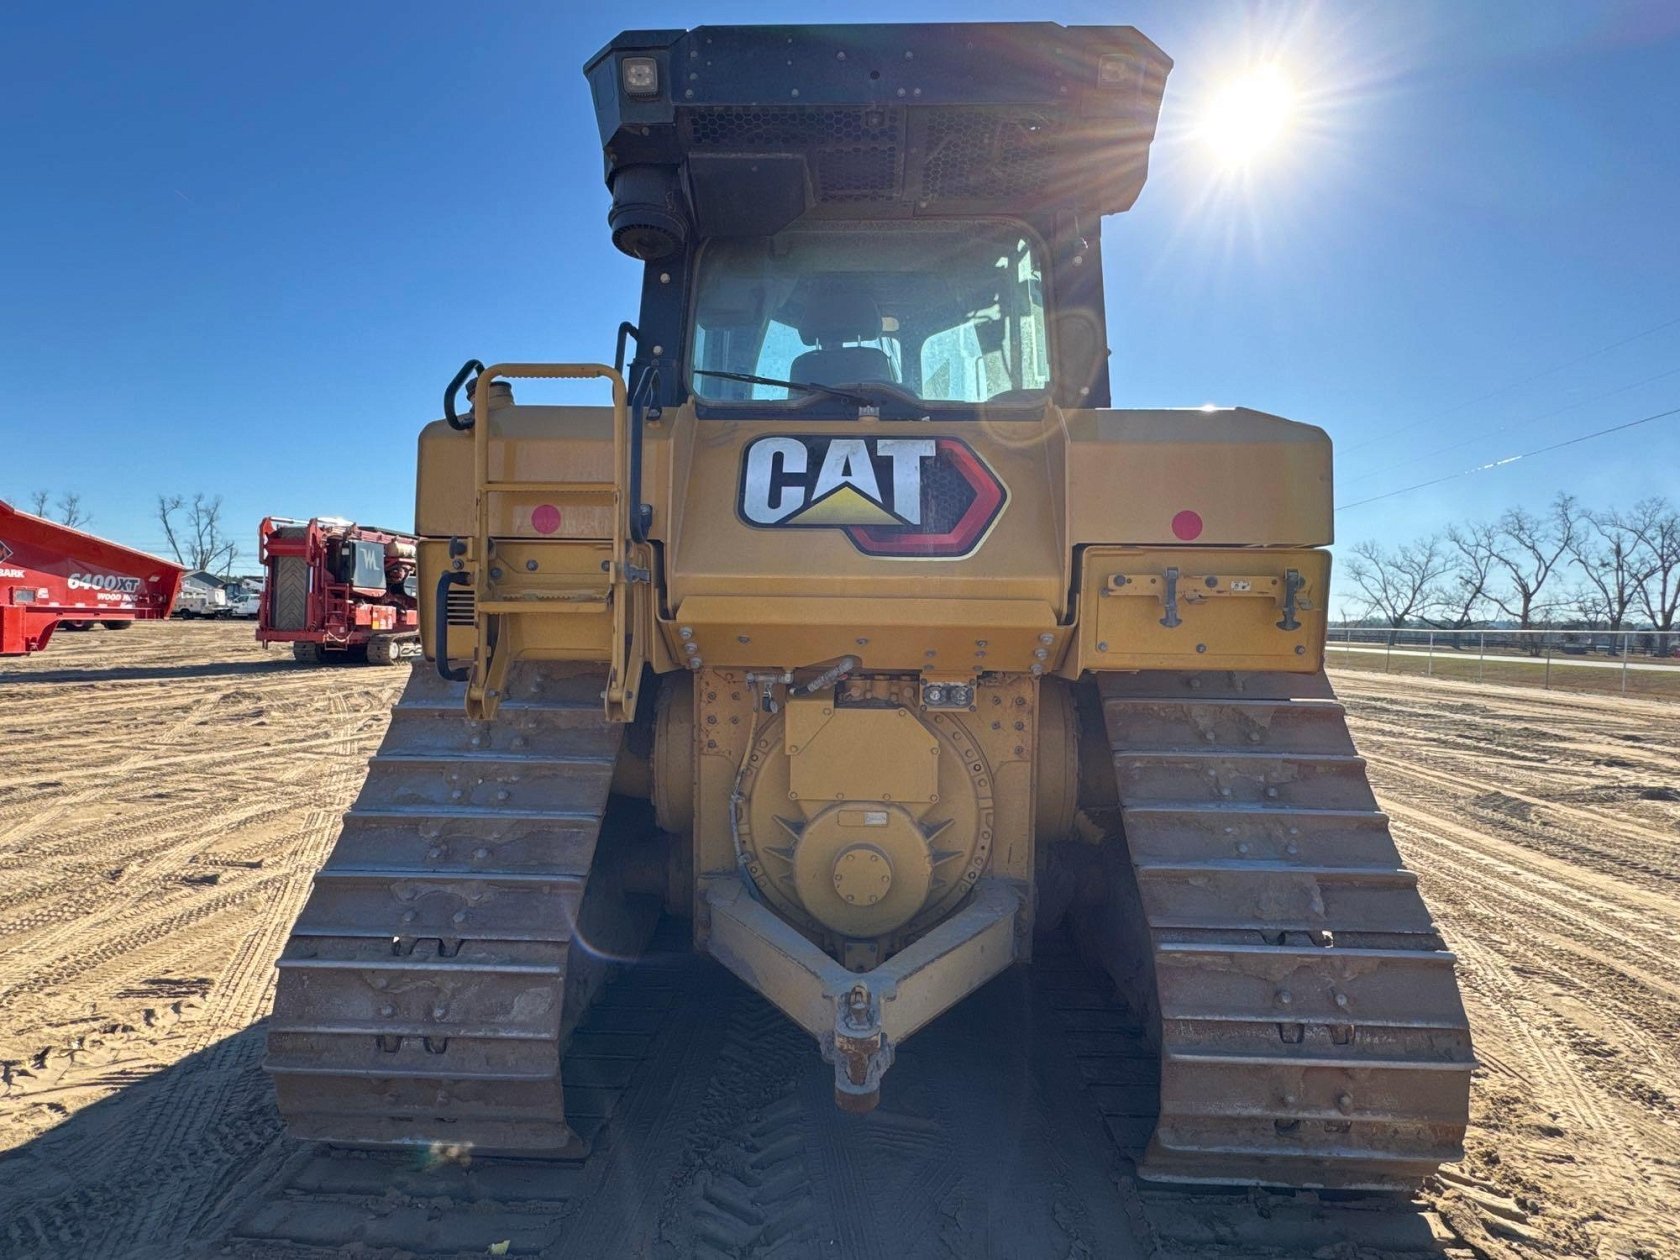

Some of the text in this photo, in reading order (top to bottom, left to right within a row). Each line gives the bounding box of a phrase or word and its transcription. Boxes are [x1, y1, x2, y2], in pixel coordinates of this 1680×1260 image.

[743, 437, 936, 525] CAT
[67, 573, 141, 593] 6400XT
[97, 592, 121, 601] WOOD
